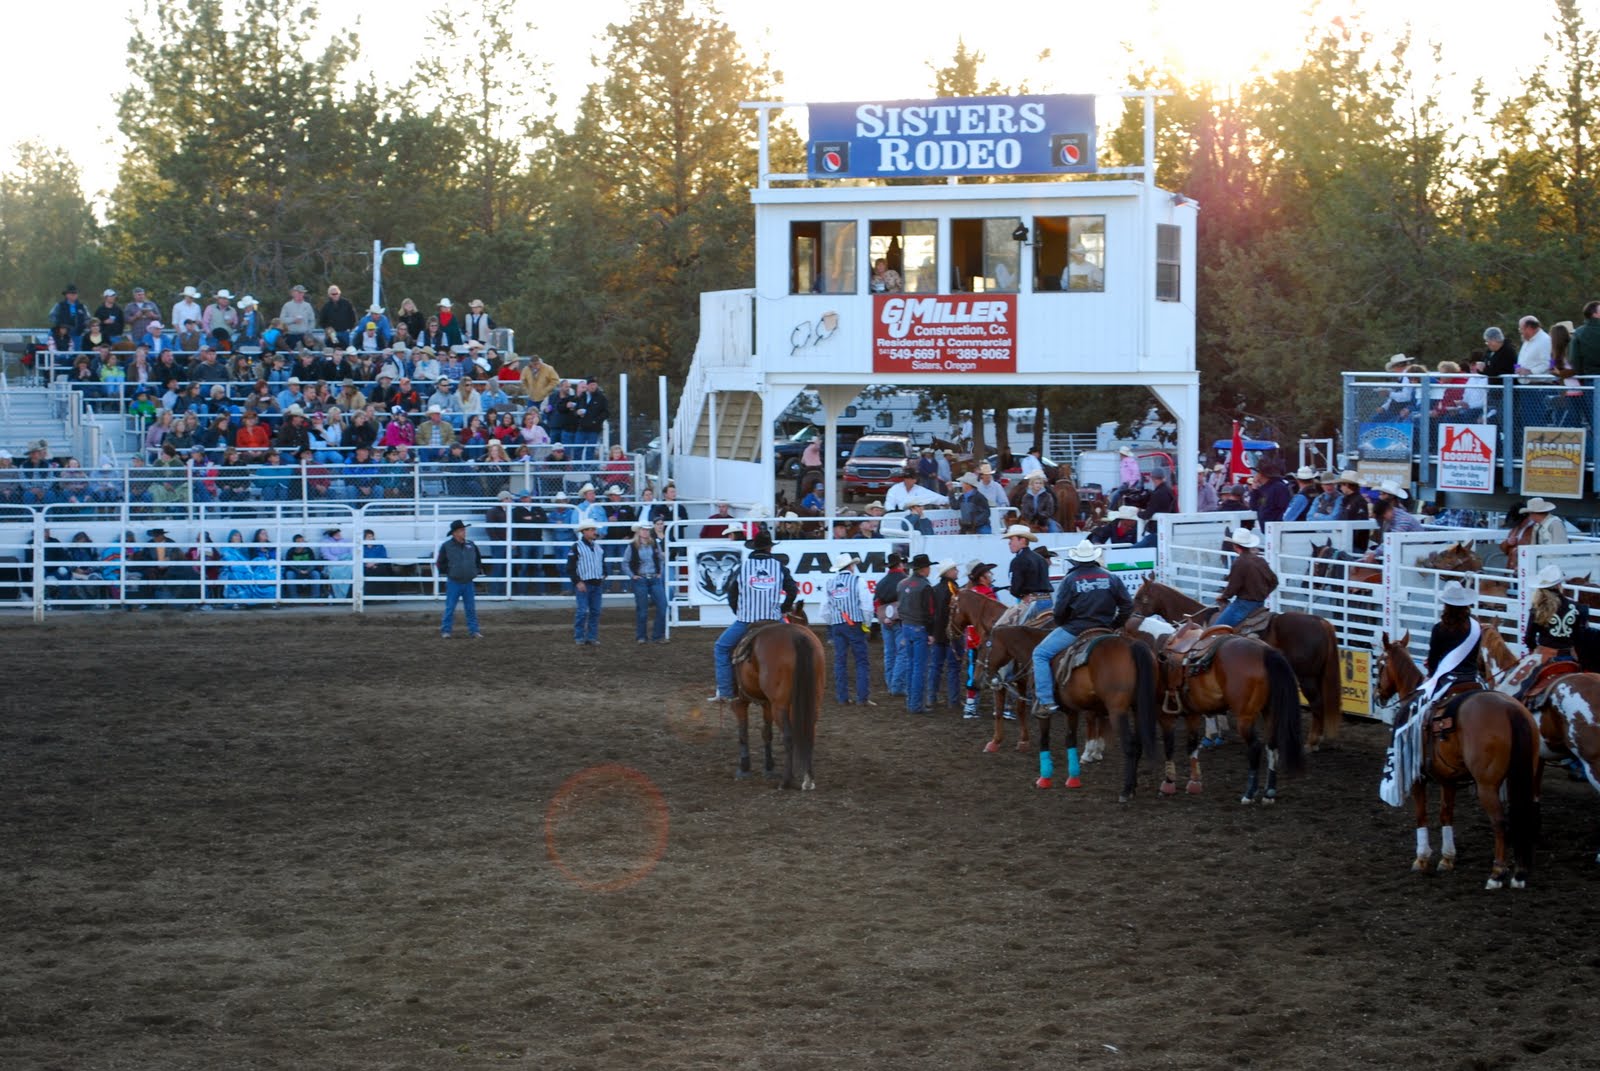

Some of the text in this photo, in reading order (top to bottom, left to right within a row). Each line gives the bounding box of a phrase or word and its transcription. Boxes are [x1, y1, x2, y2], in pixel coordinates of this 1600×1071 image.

[855, 102, 1046, 138] SISTERS
[877, 138, 1022, 172] RODEO
[914, 324, 1008, 337] Construction, Co.
[876, 338, 1012, 347] Residential & Commercial
[890, 348, 941, 359] 549-6691
[956, 348, 1010, 360] 389-9062
[911, 360, 977, 372] Sisters, Oregon
